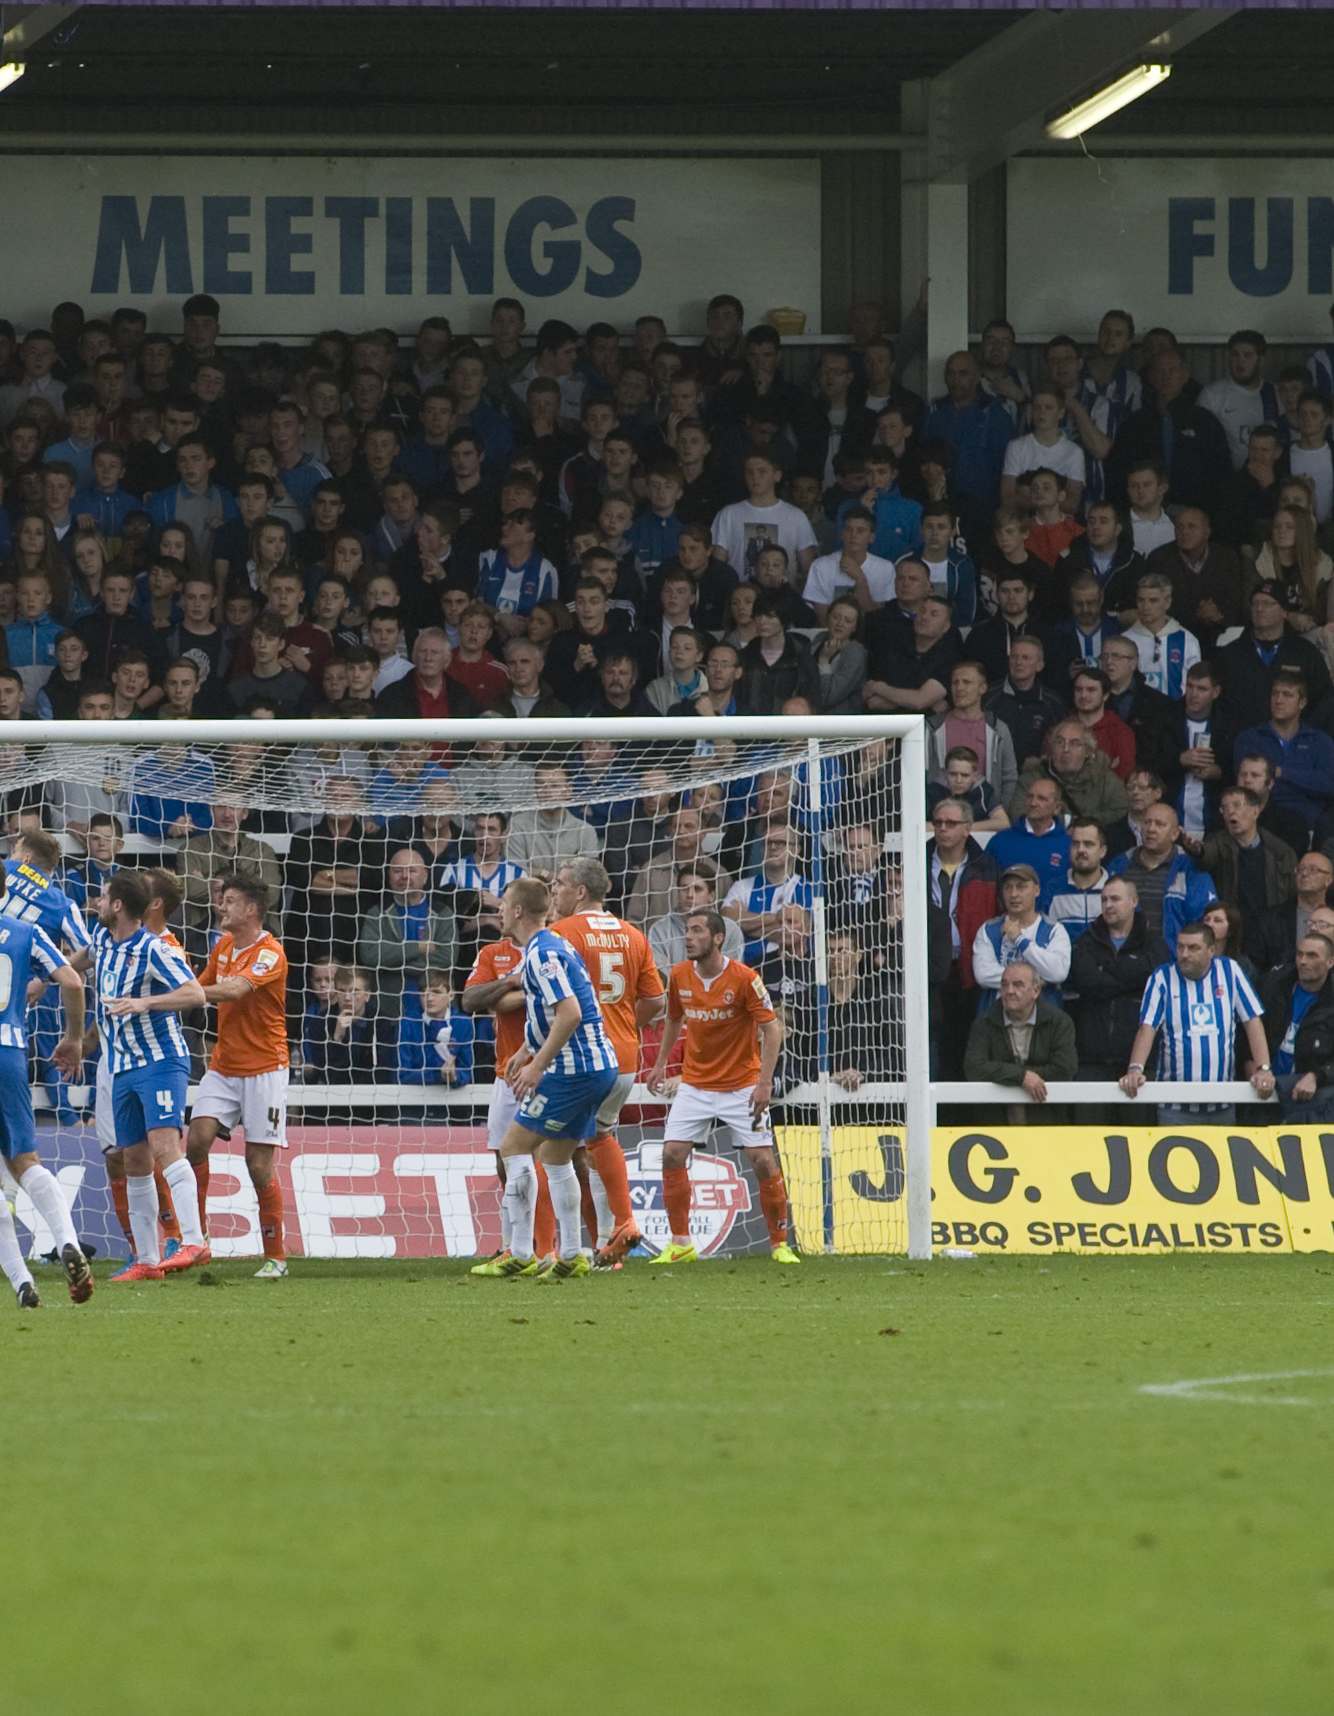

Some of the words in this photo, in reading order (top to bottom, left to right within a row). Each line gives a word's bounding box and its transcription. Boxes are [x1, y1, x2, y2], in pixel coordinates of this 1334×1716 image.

[90, 195, 643, 298] MEETINGS
[17, 863, 50, 890] DEAN
[599, 952, 626, 1004] 5
[685, 1008, 734, 1022] easyJet
[156, 1090, 174, 1113] 4
[268, 1107, 280, 1130] 4
[948, 1134, 1042, 1204] G.
[1071, 1133, 1334, 1206] JON
[181, 1152, 498, 1259] BET
[690, 1184, 738, 1207] ET
[931, 1222, 1008, 1249] BBQ
[1027, 1222, 1283, 1247] SPECIALISTS
